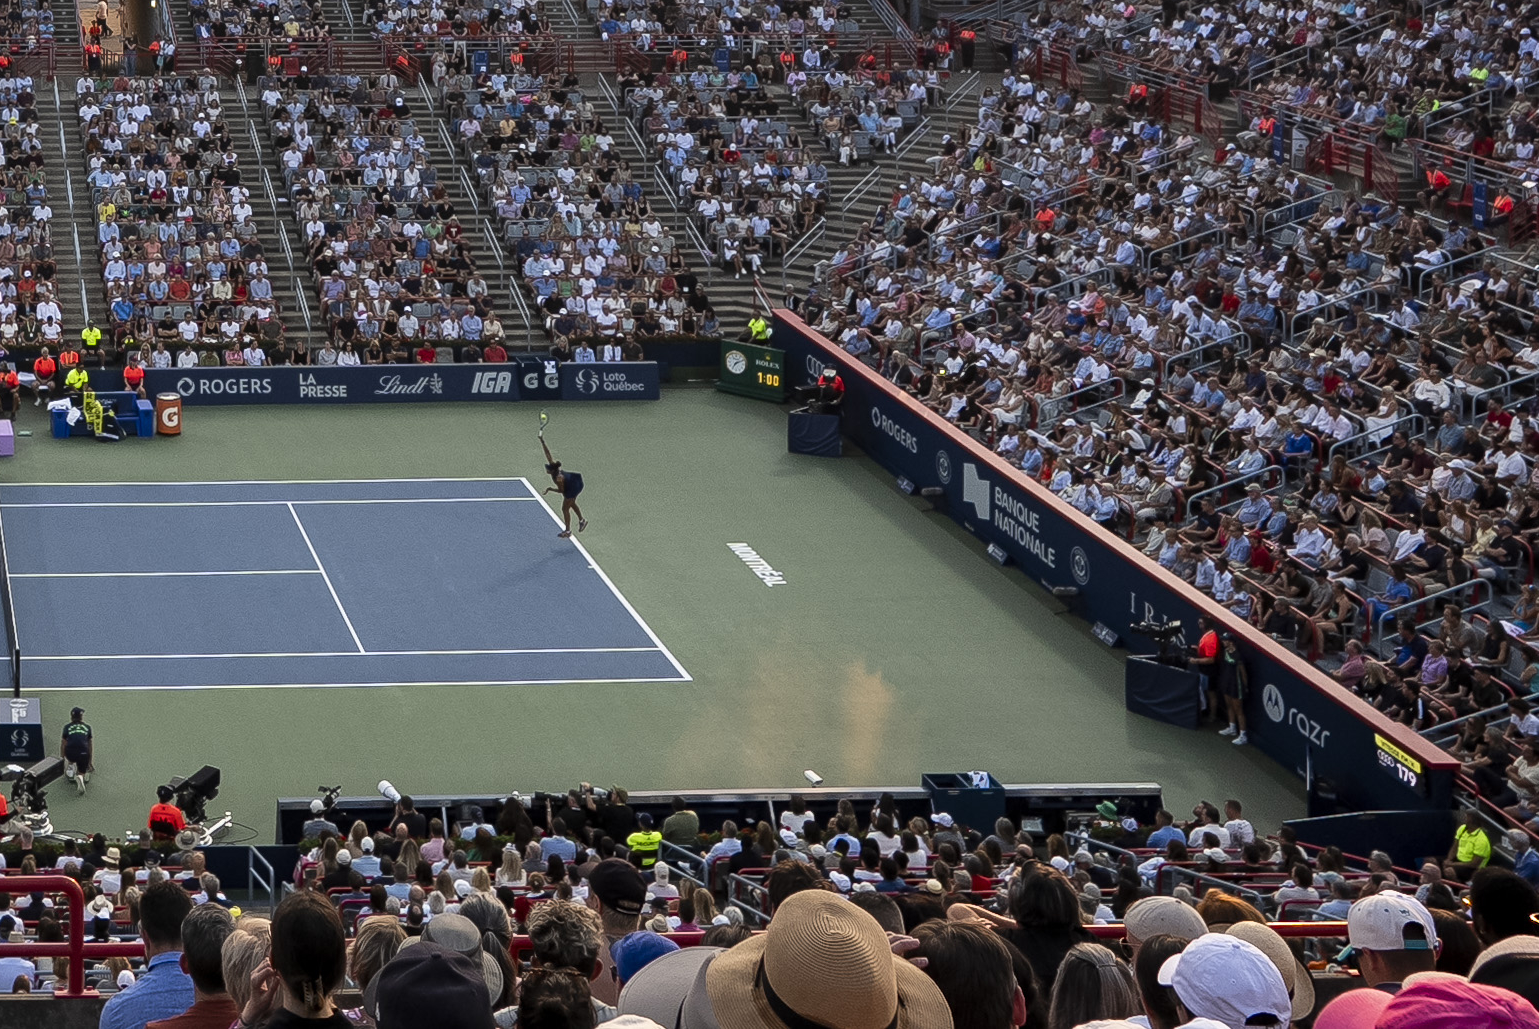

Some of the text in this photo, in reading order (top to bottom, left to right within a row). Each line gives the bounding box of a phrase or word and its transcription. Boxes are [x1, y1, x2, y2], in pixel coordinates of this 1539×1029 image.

[755, 359, 780, 370] ROLEX
[299, 373, 317, 385] LA
[374, 374, 428, 394] Lindt
[471, 372, 512, 394] IGA
[603, 372, 626, 381] Loto
[757, 371, 780, 387] 1:00
[200, 378, 272, 394] ROGERS
[300, 385, 347, 398] PRESSE
[603, 380, 645, 392] Québec
[882, 414, 918, 454] ROGERS
[994, 486, 1040, 533] BANQUE
[994, 510, 1056, 569] NATIONALE
[1288, 707, 1331, 748] razr
[1396, 763, 1417, 787] 179
